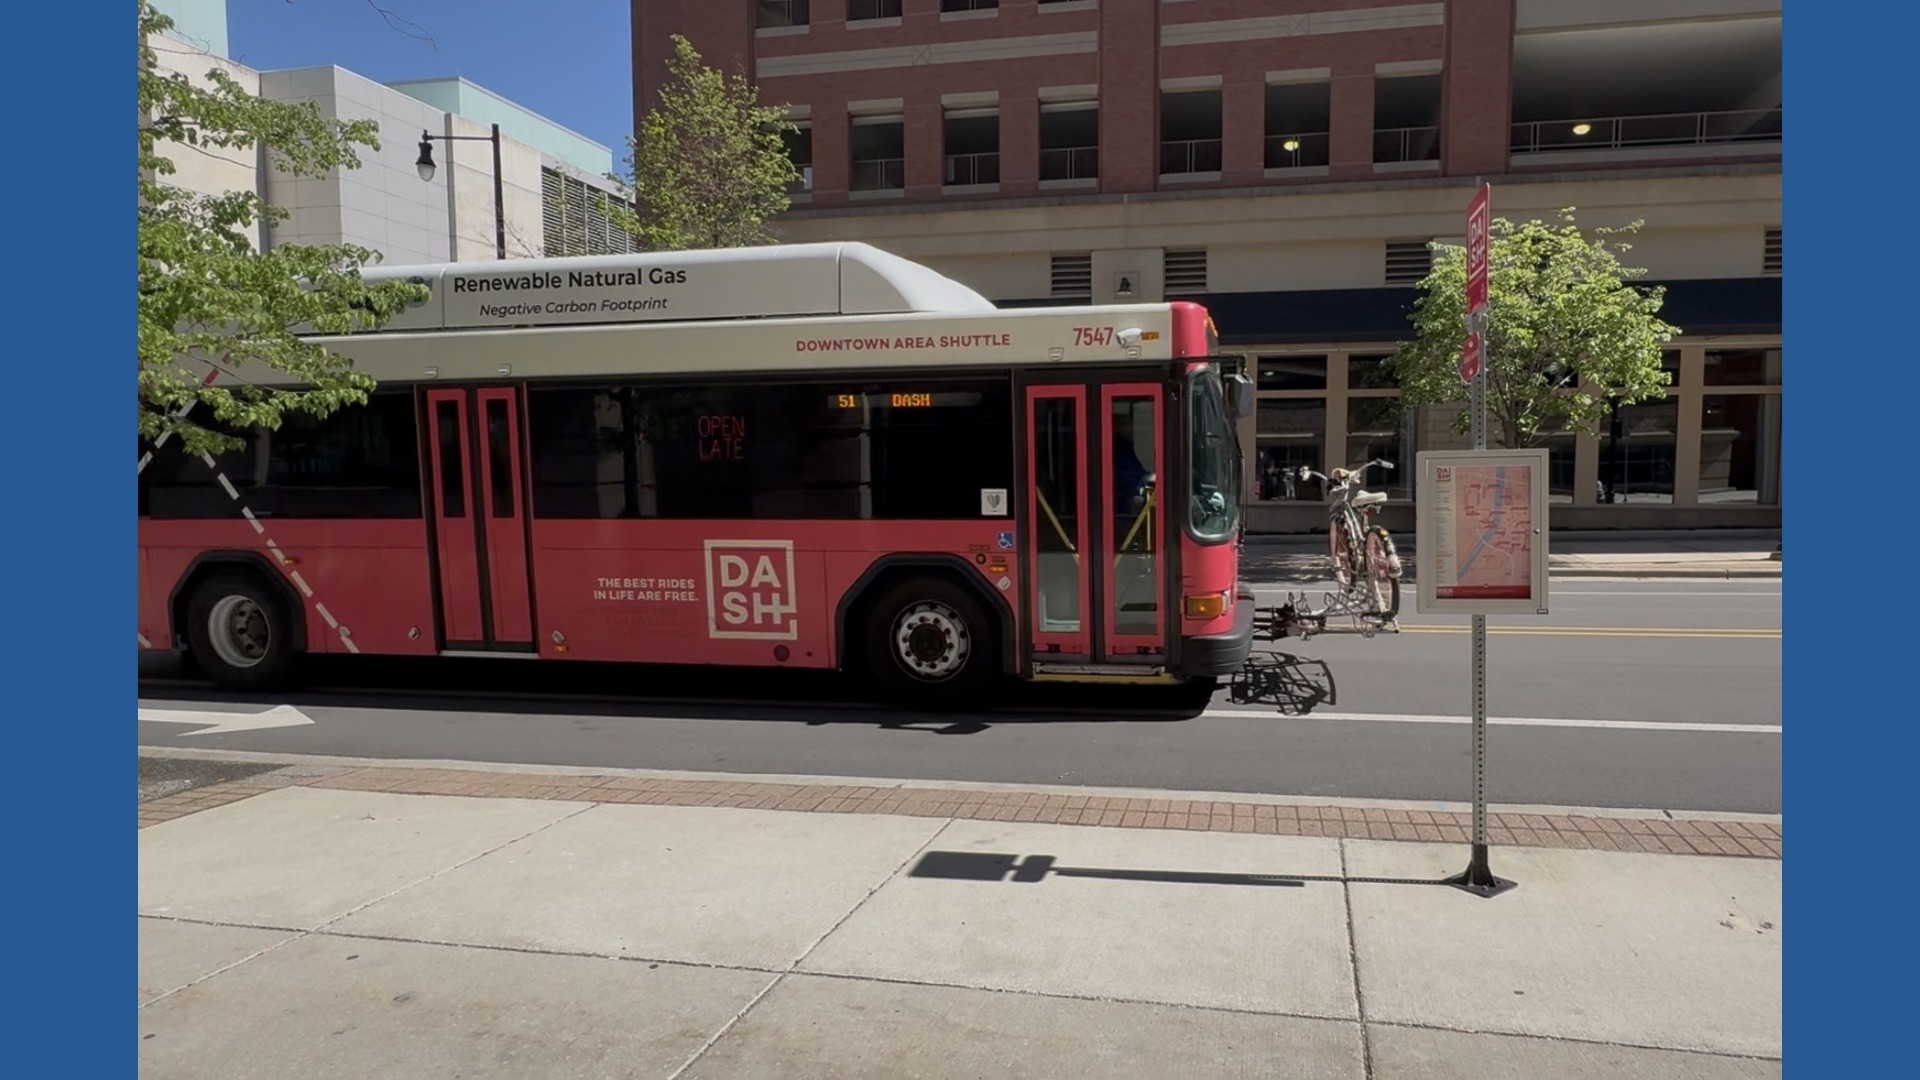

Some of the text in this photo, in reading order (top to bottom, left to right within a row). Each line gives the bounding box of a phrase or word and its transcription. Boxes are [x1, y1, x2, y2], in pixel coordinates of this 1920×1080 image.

[1471, 217, 1483, 243] DA
[1471, 239, 1484, 269] SH
[454, 267, 686, 293] Renewable Natural Gas
[479, 297, 668, 317] Negative Carbon Footprint
[796, 333, 1011, 352] DOWNTOWN AREA SHUTTLE
[1073, 327, 1114, 346] 7547
[838, 393, 930, 408] 51 DASH
[698, 415, 745, 438] OPEN
[698, 437, 745, 460] LATE
[720, 555, 781, 588] DA
[598, 578, 695, 589] THE BEST RIDES
[594, 590, 699, 602] IN LIFE ARE FREE.
[722, 591, 783, 625] SH
